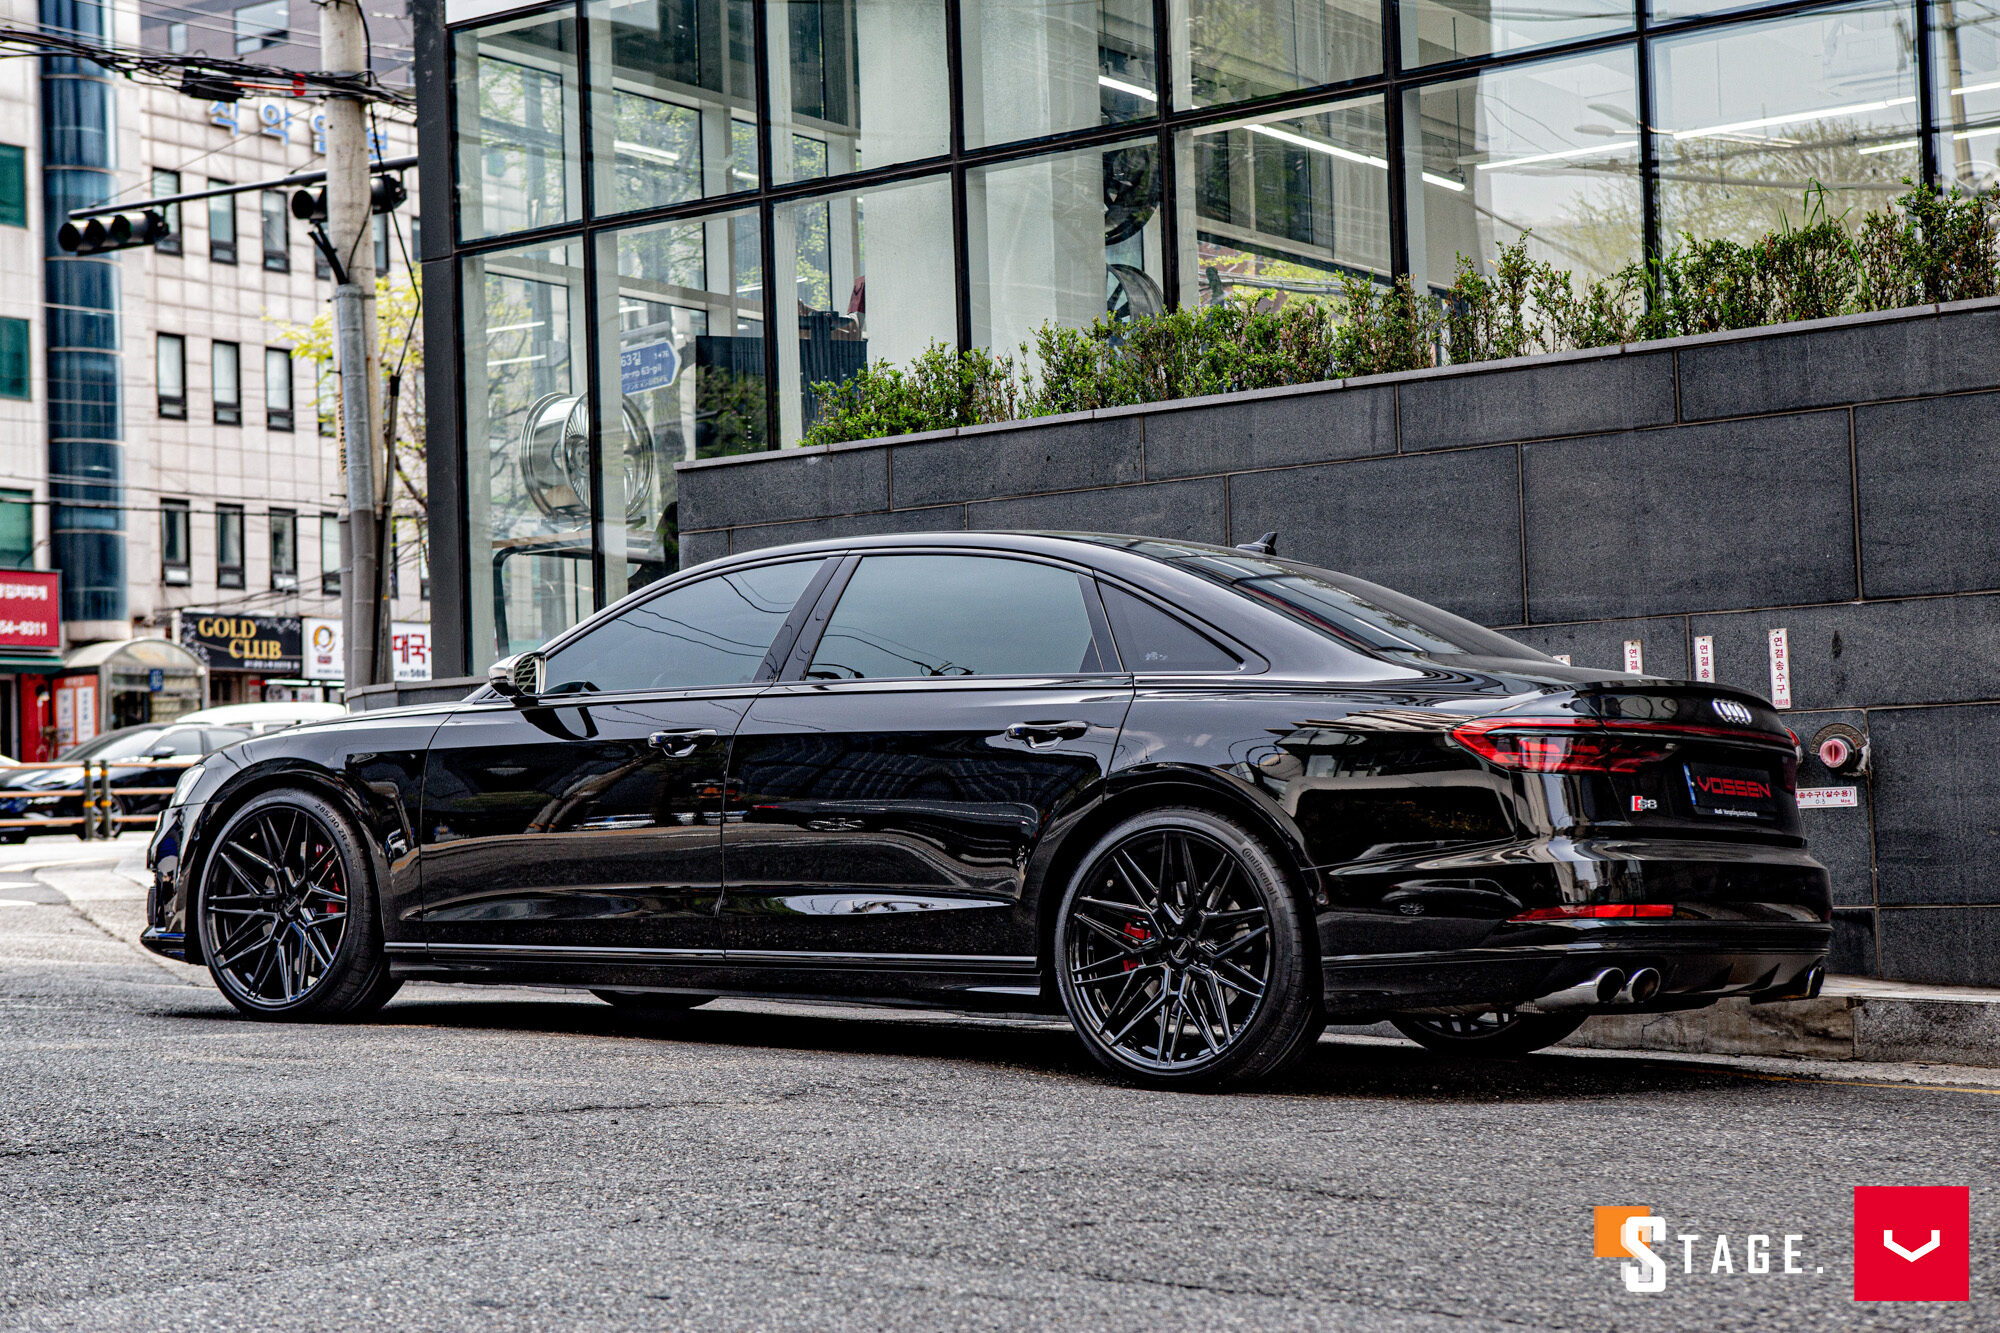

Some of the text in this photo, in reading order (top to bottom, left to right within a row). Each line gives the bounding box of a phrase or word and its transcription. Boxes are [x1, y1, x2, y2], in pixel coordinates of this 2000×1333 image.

[198, 617, 257, 639] GOLD
[229, 638, 282, 659] CLUB
[1628, 648, 1638, 670] 연결
[1699, 644, 1710, 682] 연결송
[1774, 637, 1786, 694] 연결송수구
[1697, 776, 1772, 798] VOSSEN
[1638, 798, 1658, 810] S8
[315, 802, 340, 829] 285/30
[338, 828, 348, 842] ZR
[1241, 847, 1277, 896] Continental
